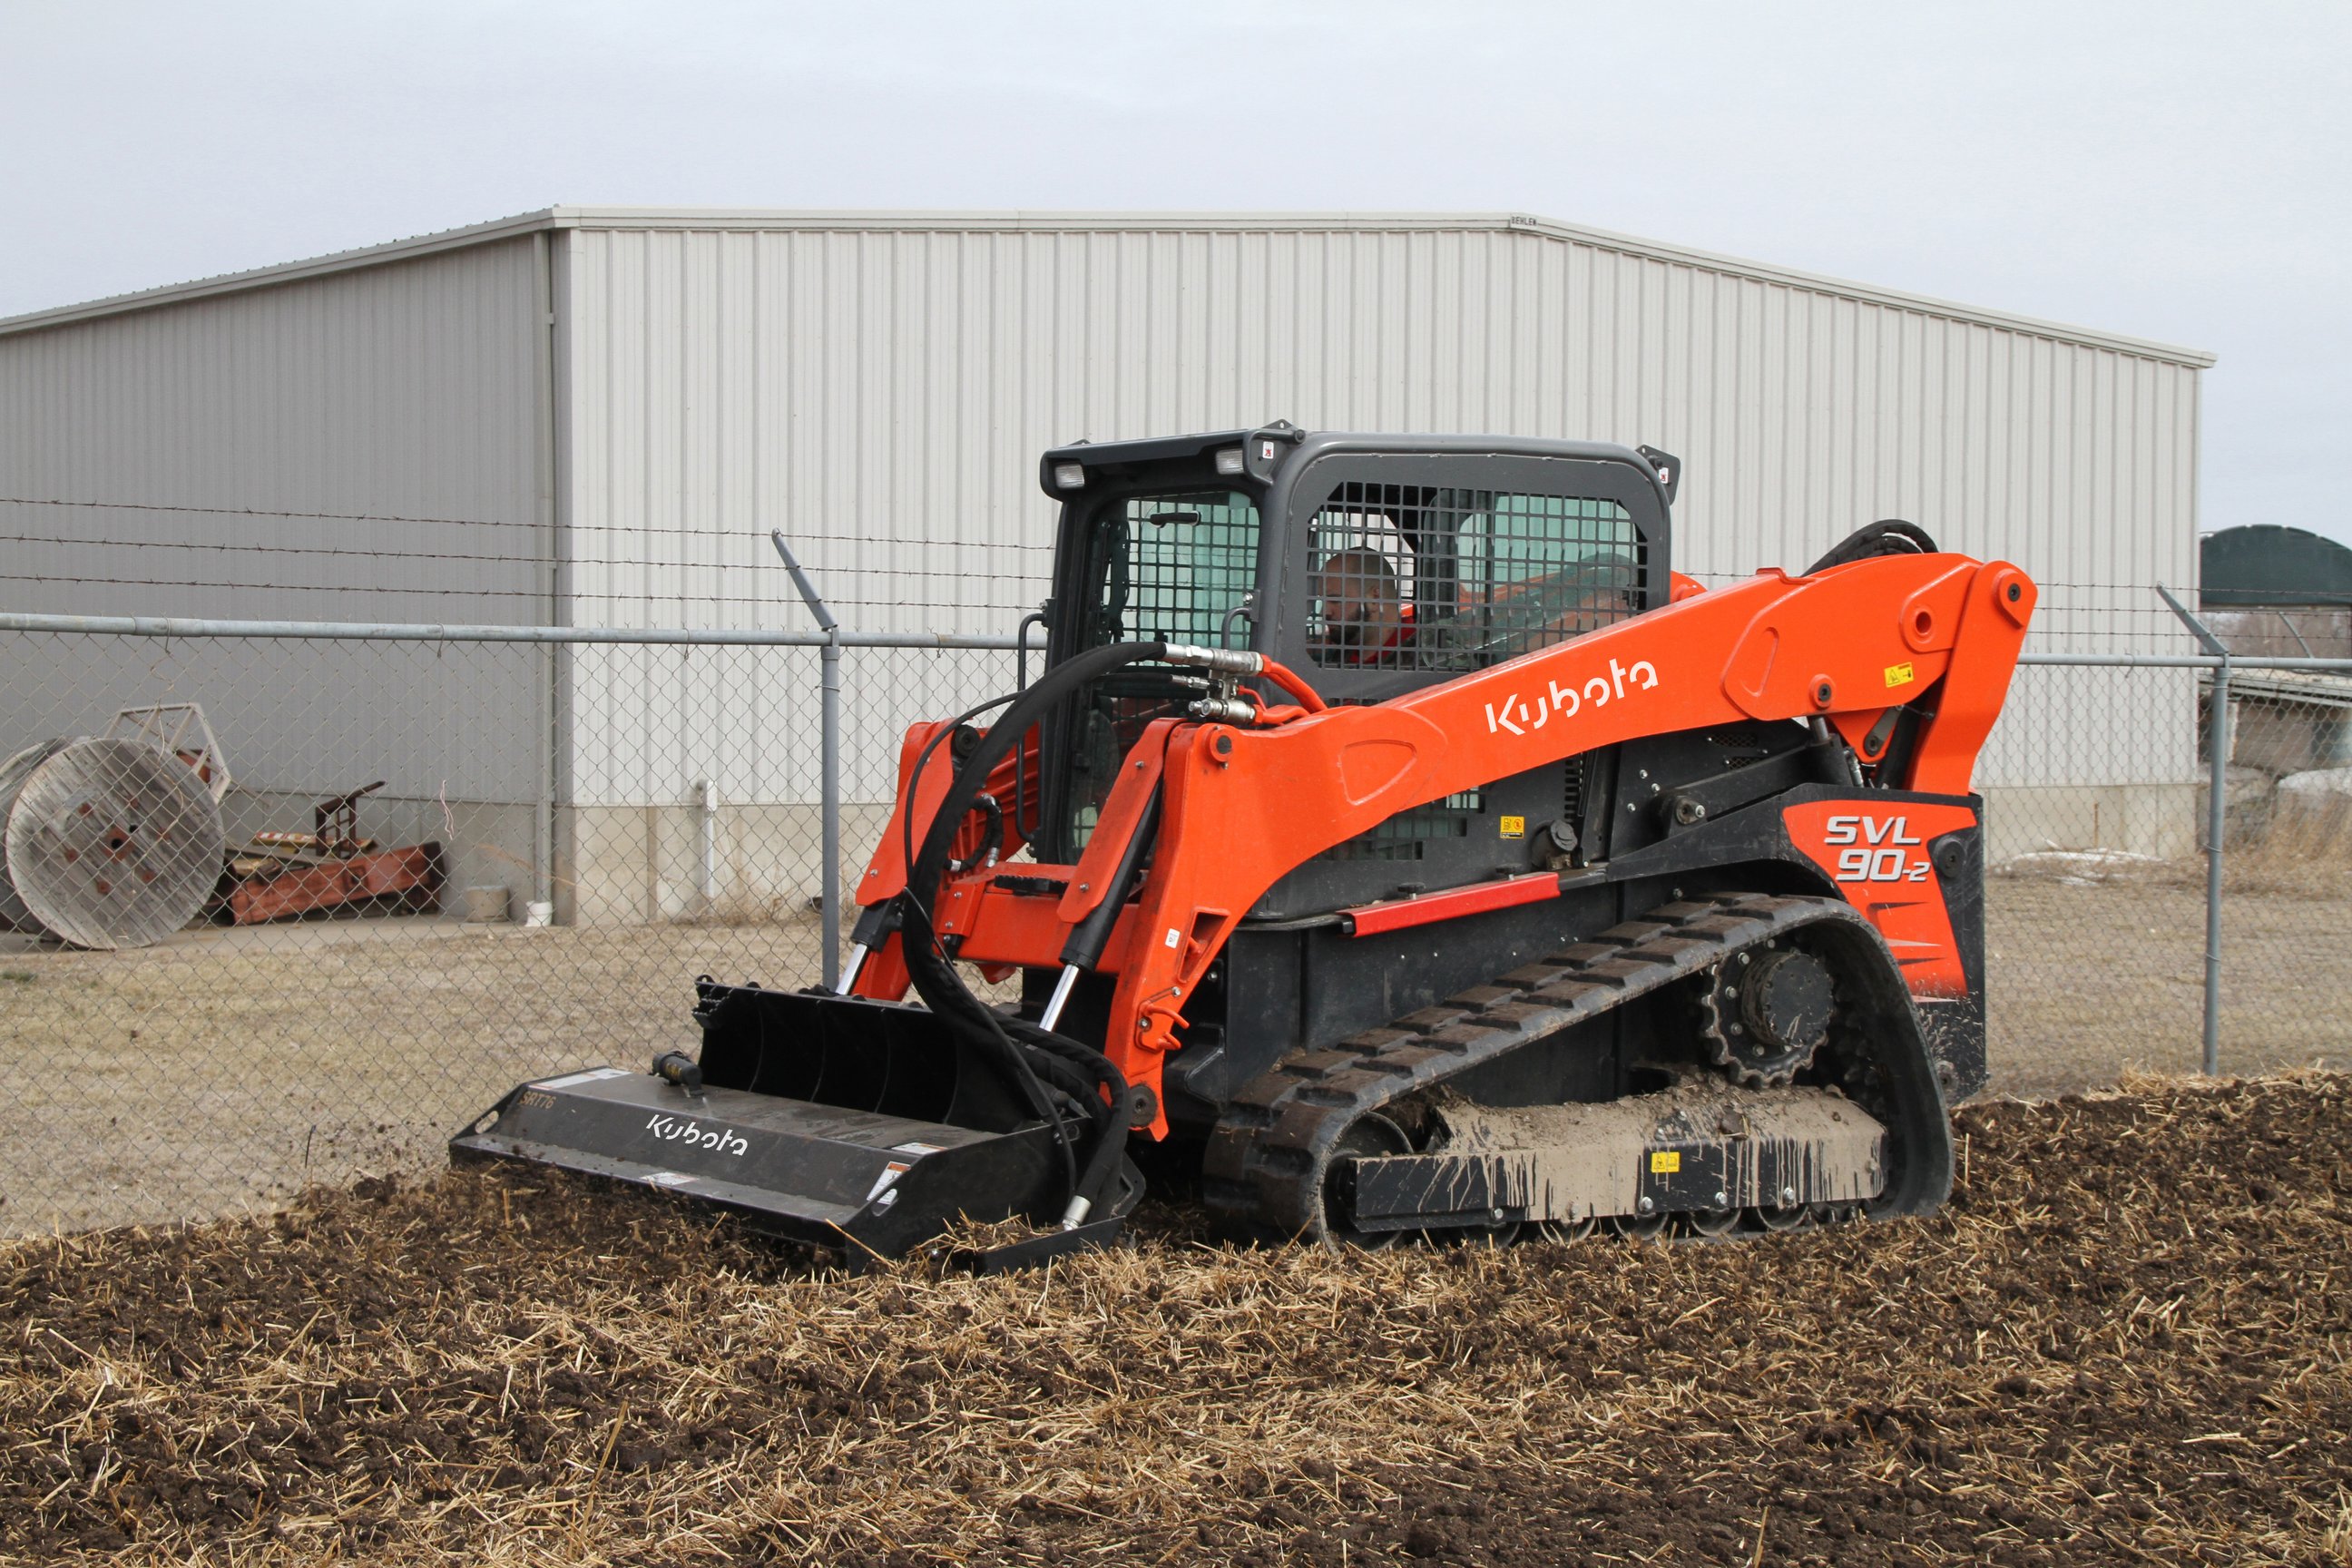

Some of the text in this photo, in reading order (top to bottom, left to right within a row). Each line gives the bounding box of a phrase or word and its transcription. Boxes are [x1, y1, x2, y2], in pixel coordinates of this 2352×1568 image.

[1485, 658, 1659, 736] Kubota
[1824, 816, 1921, 845] SVL
[1835, 848, 1931, 882] 90-2
[645, 1114, 749, 1156] Kubota
